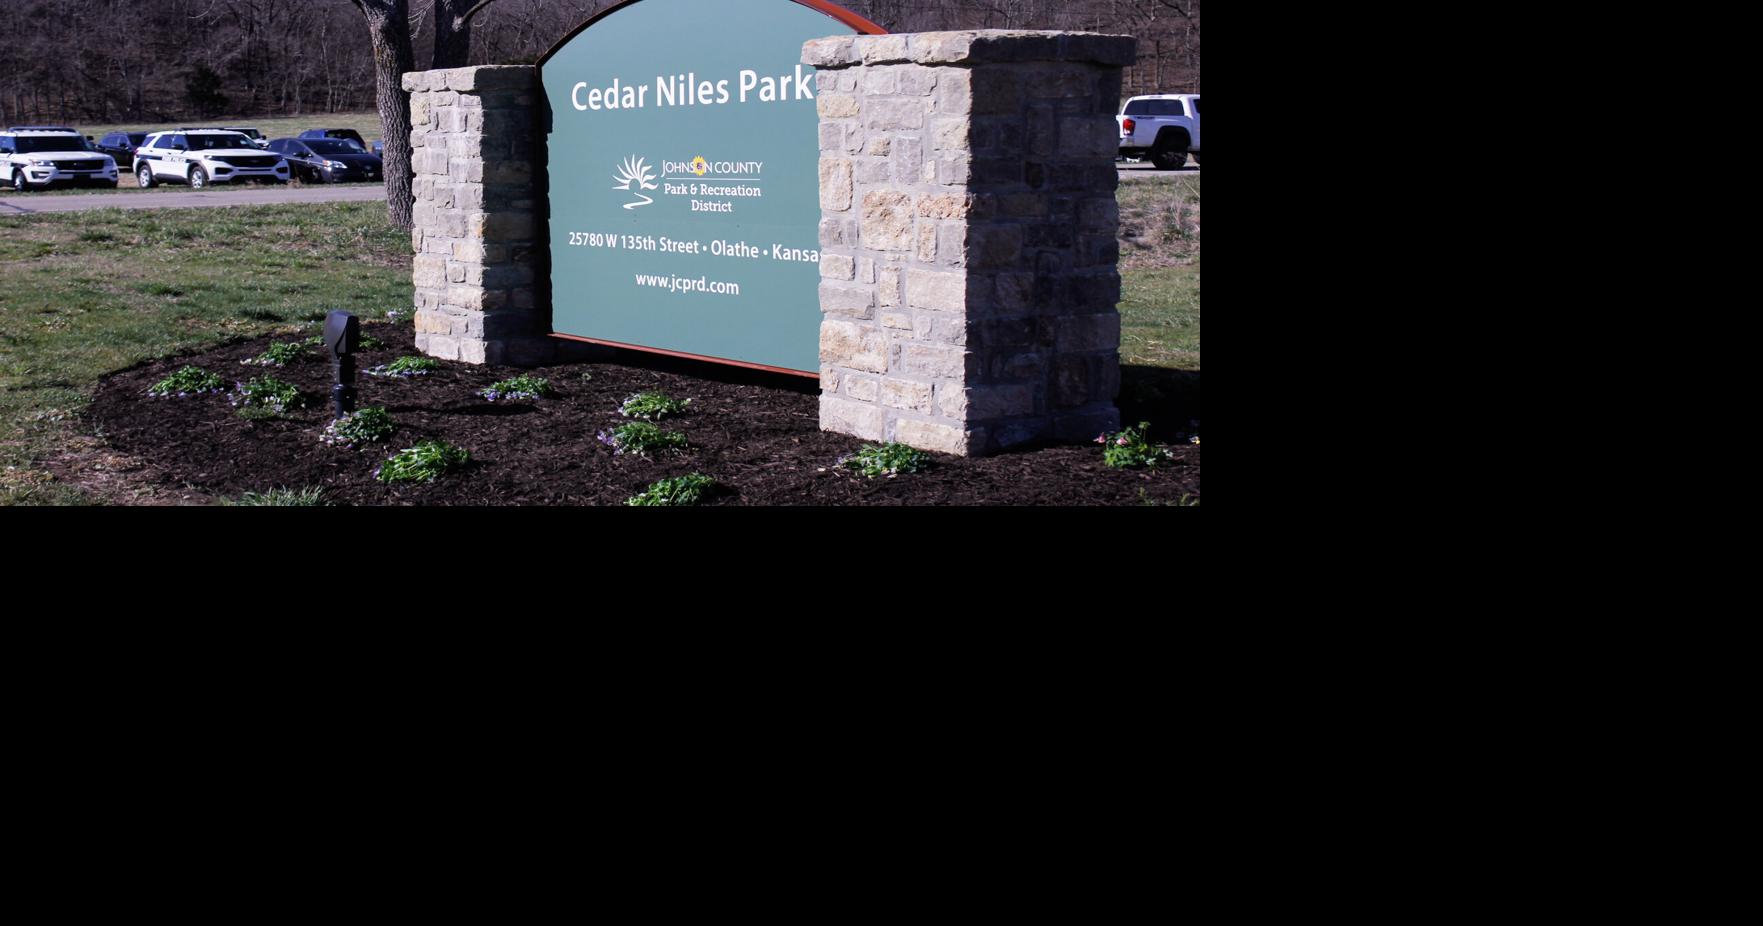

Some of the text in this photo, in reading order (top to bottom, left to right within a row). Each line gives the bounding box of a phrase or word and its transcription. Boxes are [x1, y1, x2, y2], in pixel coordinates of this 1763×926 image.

[571, 64, 814, 111] Cedar Niles Park
[714, 161, 763, 174] COUNTY
[664, 183, 761, 197] Park & Recreation
[691, 199, 732, 213] District
[568, 231, 822, 262] 25780 W 135th Street Olathe Kansa
[635, 273, 740, 295] www.jcprd.com
